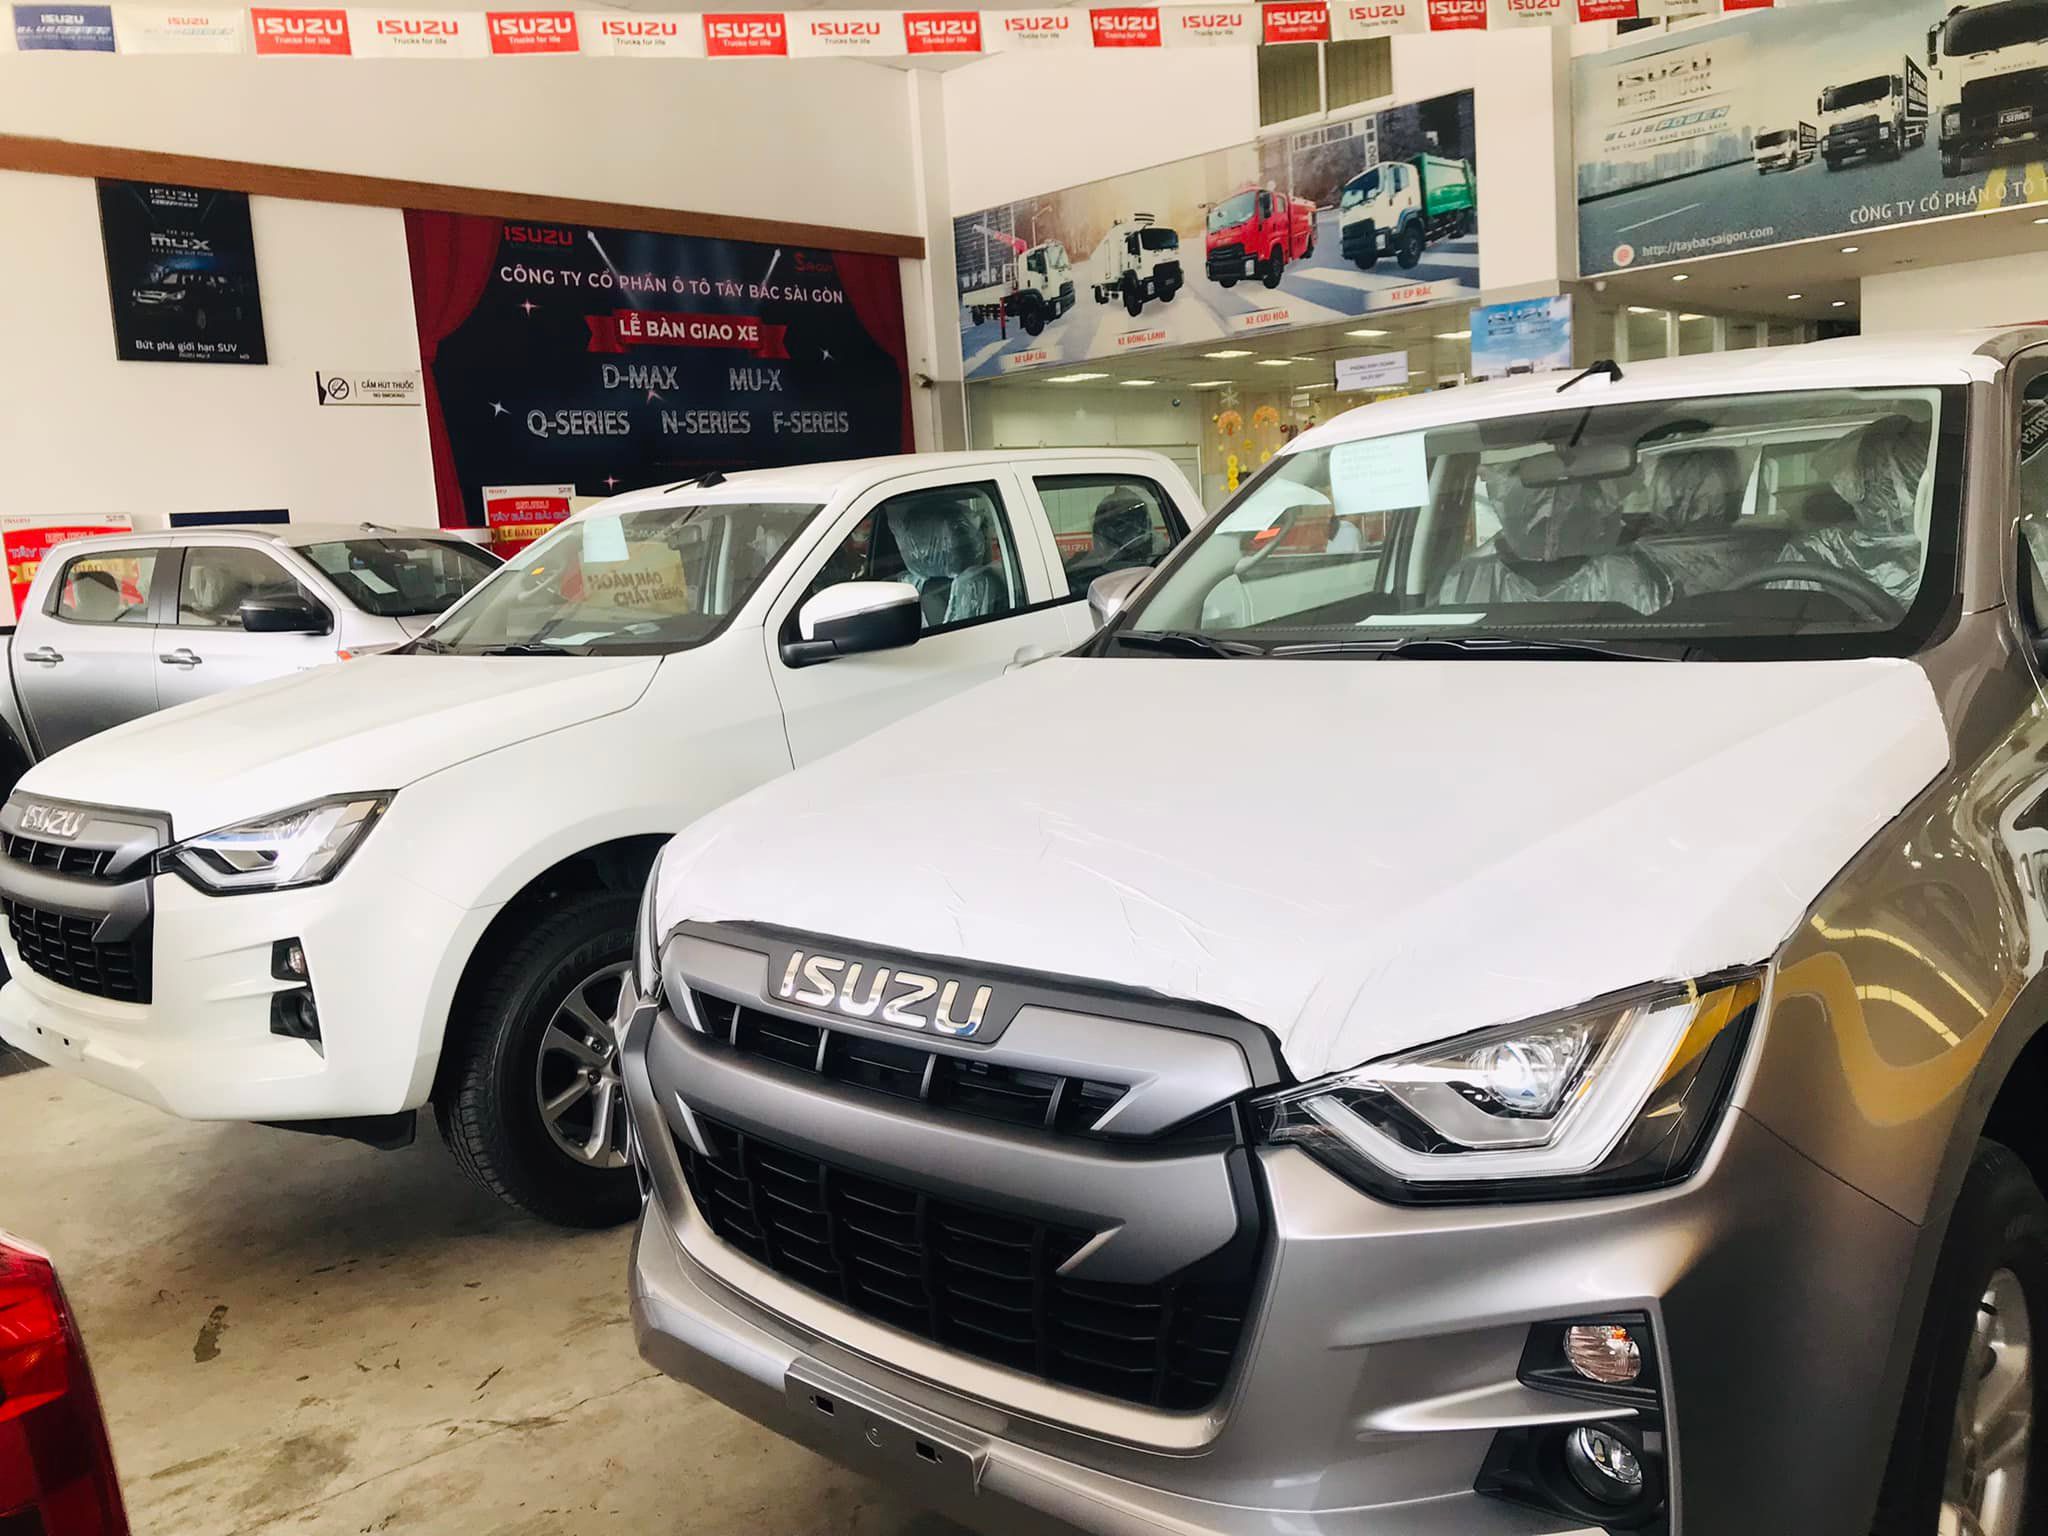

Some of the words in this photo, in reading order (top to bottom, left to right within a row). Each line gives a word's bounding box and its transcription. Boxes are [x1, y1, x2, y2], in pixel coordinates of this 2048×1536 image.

[1350, 5, 1406, 20] ISUZU
[1430, 0, 1486, 15] ISUZU
[1508, 0, 1560, 10] ISUZU
[41, 14, 84, 25] ISUZU
[257, 17, 343, 35] ISUZU
[1005, 16, 1069, 32] ISUZU
[1093, 16, 1157, 31] ISUZU
[1182, 14, 1243, 29] ISUZU
[1267, 10, 1326, 26] ISUZU
[377, 20, 458, 35] ISUZU
[493, 18, 572, 35] ISUZU
[602, 21, 677, 36] ISUZU
[709, 22, 782, 38] ISUZU
[811, 22, 880, 36] ISUZU
[909, 20, 977, 37] ISUZU
[1850, 203, 1892, 225] CÔNG
[1896, 200, 1916, 217] TY
[503, 226, 573, 246] ISUZU
[1641, 226, 1774, 257] http://taybacsaigon.com
[500, 263, 555, 285] CÔNG
[560, 271, 582, 287] TY
[588, 267, 613, 289] CỔ
[672, 275, 685, 294] Ô
[689, 277, 711, 296] TÔ
[715, 279, 744, 297] TÂY
[784, 284, 808, 302] SÀI
[812, 286, 844, 304] GÒN
[619, 312, 642, 337] LỄ
[646, 317, 686, 339] BÀN
[690, 323, 733, 341] GIAO
[737, 325, 760, 342] XE
[217, 343, 238, 353] SUV
[602, 363, 680, 391] D-MAX
[729, 366, 783, 392] MU-X
[526, 409, 631, 439] Q-SERIES
[661, 409, 751, 435] N-SERIES
[772, 410, 850, 434] F-SEREIS
[21, 805, 86, 837] ISUZU
[780, 951, 993, 1037] ISUZU
